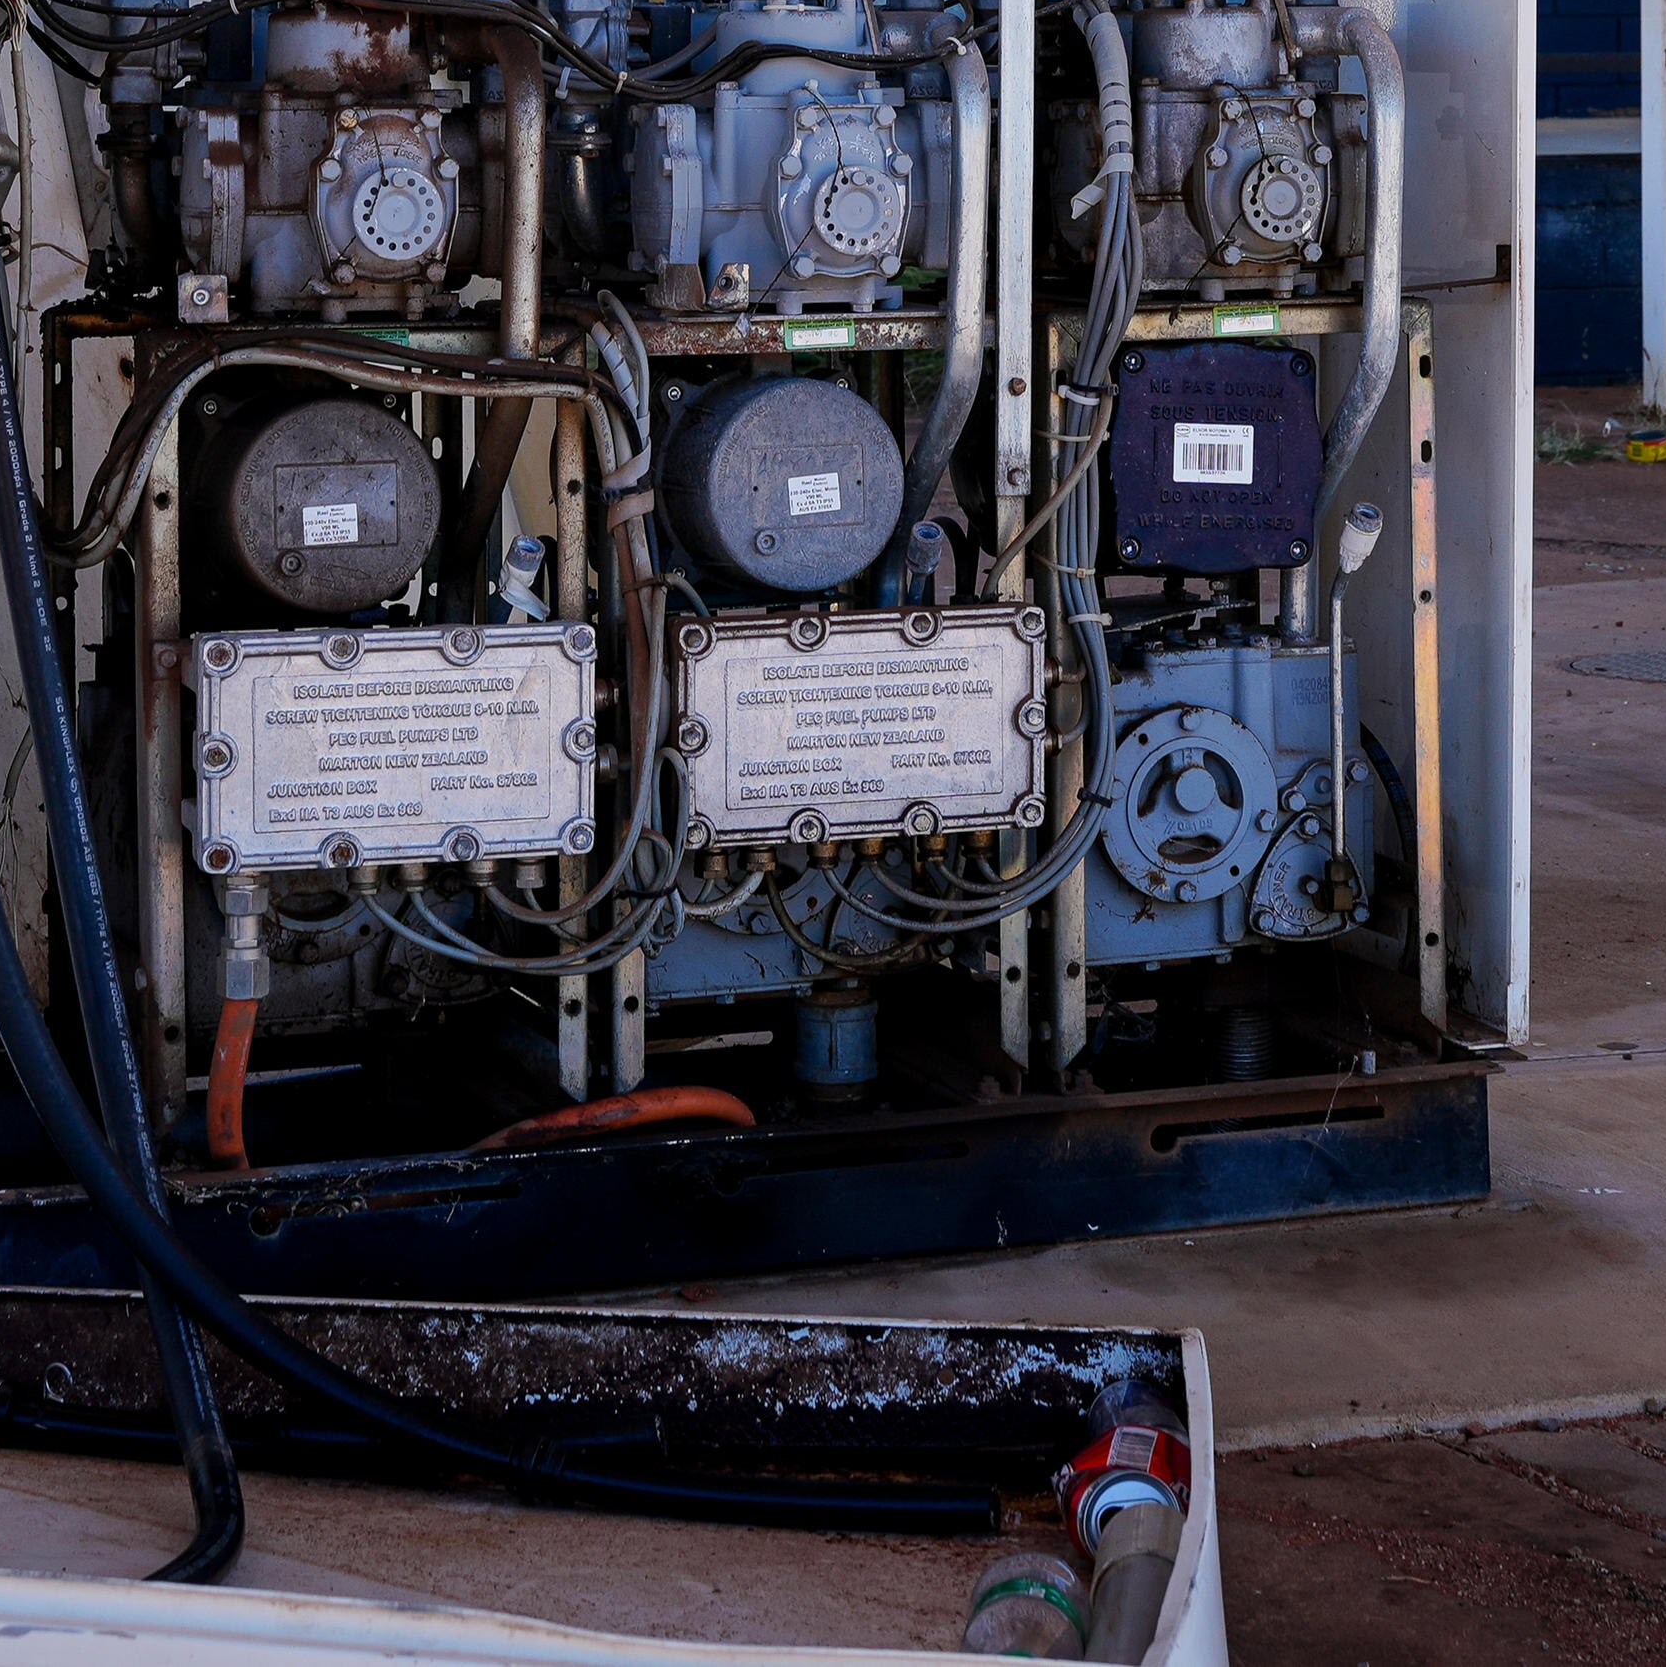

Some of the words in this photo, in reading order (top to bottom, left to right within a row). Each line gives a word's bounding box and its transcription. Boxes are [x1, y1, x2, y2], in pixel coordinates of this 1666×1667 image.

[1150, 380, 1171, 394] NE
[1182, 381, 1215, 394] PAS
[1224, 384, 1284, 399] OUVRIR
[1151, 406, 1194, 420] SOUS
[1205, 407, 1280, 422] TENSION
[5, 418, 14, 437] WP
[8, 439, 22, 489] 2000kpa
[241, 450, 265, 506] REMOVING
[267, 418, 301, 445] COVER
[1160, 489, 1181, 503] DO
[1189, 490, 1222, 504] NOT
[1228, 490, 1273, 505] OPEN
[18, 499, 30, 533] Grade
[1201, 516, 1295, 532] ENERGISED
[28, 554, 39, 578] kind
[36, 597, 48, 628] SOE
[43, 636, 52, 652] 22
[763, 665, 821, 681] ISOLATE
[822, 662, 874, 678] BEFORE
[876, 658, 970, 675] DISMANTLING
[293, 685, 354, 699] ISOLATE
[356, 681, 412, 696] BEFORE
[415, 676, 514, 694] DISMANTLING
[736, 691, 787, 705] SCREW
[790, 686, 872, 703] TIGHTENING
[874, 684, 930, 699] TORQUE
[54, 696, 64, 713] SC
[265, 709, 319, 725] SCREW
[322, 705, 410, 722] TIGHTENING
[411, 703, 472, 718] TORQUE
[474, 701, 504, 715] 8-10
[796, 711, 823, 726] PEC
[825, 709, 860, 725] FUEL
[861, 707, 910, 723] PUMPS
[911, 706, 937, 720] LTD
[56, 716, 76, 774] KINGFLEX
[328, 733, 358, 747] PEC
[359, 730, 396, 745] FUEL
[399, 728, 450, 744] PUMPS
[451, 726, 479, 741] LTD
[787, 735, 847, 750] MARTON
[849, 733, 881, 747] NEW
[883, 729, 945, 745] ZEALAND
[318, 757, 382, 772] MARTON
[385, 754, 419, 769] NEW
[421, 750, 488, 767] ZEALAND
[738, 760, 811, 777] JUNCTION
[812, 757, 843, 772] BOX
[891, 754, 926, 769] PART
[928, 753, 952, 767] No.
[266, 782, 344, 799] JUNCTION
[346, 780, 378, 795] BOX
[430, 776, 466, 791] PART
[469, 775, 495, 790] No.
[495, 772, 538, 788] 87802
[741, 786, 767, 800] Exd
[790, 783, 808, 797] T3
[810, 781, 840, 796] AUS
[842, 780, 861, 794] Ex
[861, 780, 885, 793] 969
[73, 796, 88, 844] GP0502
[268, 807, 296, 824] Exd
[322, 805, 341, 820] T3
[342, 803, 375, 820] AUS
[377, 802, 396, 817] Ex
[397, 802, 423, 817] 969
[83, 846, 93, 862] AS
[87, 865, 99, 896] 2683
[95, 909, 107, 937] TYPE
